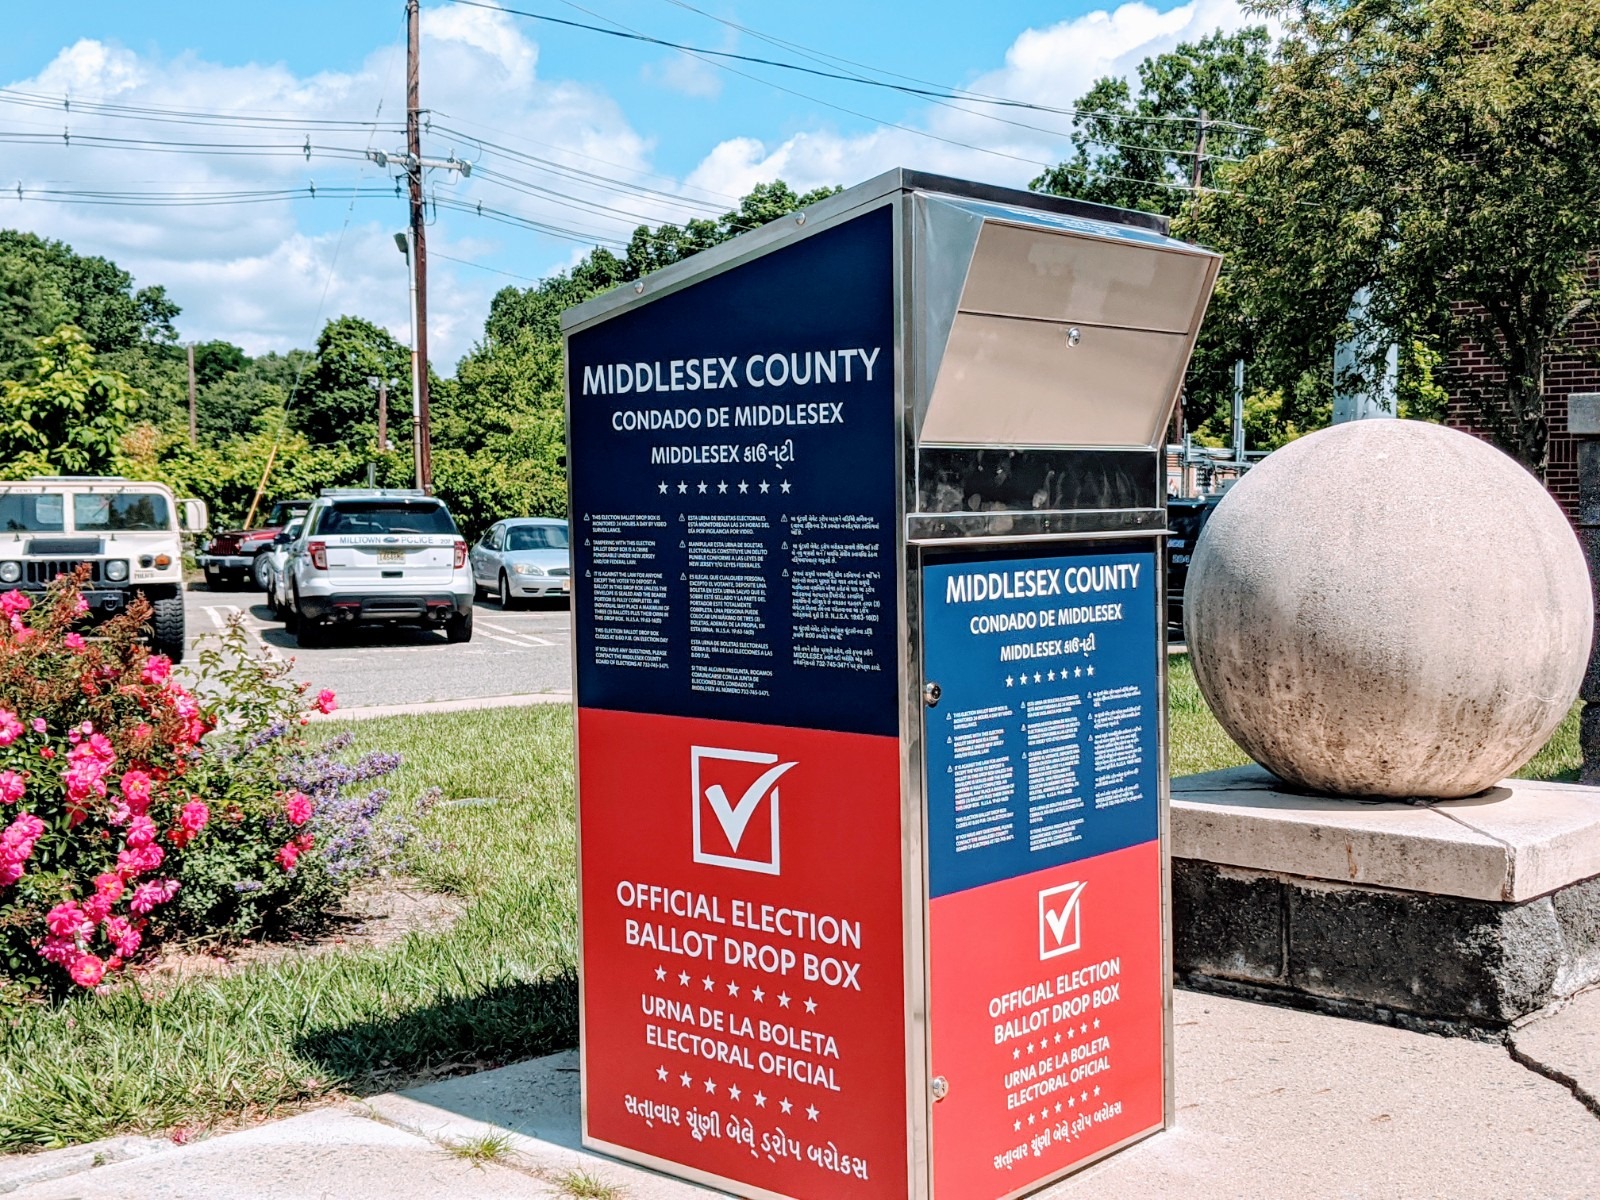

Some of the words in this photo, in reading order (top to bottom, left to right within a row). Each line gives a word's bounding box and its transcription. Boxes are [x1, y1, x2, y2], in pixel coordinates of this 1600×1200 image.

[583, 357, 738, 395] MIDDLESEX
[746, 347, 880, 387] COUNTY
[612, 408, 702, 431] CONDADO
[706, 407, 729, 428] DE
[734, 402, 844, 426] MIDDLESEX
[651, 445, 740, 464] MIDDLESEX
[340, 536, 381, 544] MILLTOWN
[401, 536, 434, 544] POLICE
[946, 568, 1061, 603] MIDDLESEX
[1064, 563, 1140, 594] COUNTY
[970, 612, 1036, 635] CONDADO
[1040, 610, 1055, 628] DE
[1058, 603, 1122, 626] MIDDLESEX
[1000, 640, 1062, 662] MIDDLESEX
[617, 881, 726, 924] OFFICIAL
[732, 900, 861, 949] ELECTION
[625, 919, 717, 961] BALLOT
[725, 938, 796, 975] DROP
[804, 953, 861, 991] BOX
[988, 980, 1054, 1018] OFFICIAL
[1057, 957, 1120, 994] ELECTION
[994, 1008, 1049, 1045] BALLOT
[1052, 996, 1090, 1026] DROP
[1093, 983, 1120, 1010] BOX
[642, 994, 696, 1025] URNA
[700, 1007, 723, 1032] DE
[730, 1014, 755, 1039] LA
[760, 1020, 839, 1059] BOLETA
[646, 1024, 754, 1070] ELECTORAL
[758, 1051, 840, 1091] OFICIAL
[1004, 1061, 1037, 1090] URNA
[1039, 1057, 1053, 1075] DE
[1055, 1051, 1070, 1069] LA
[1071, 1035, 1110, 1063] BOLETA
[1007, 1072, 1069, 1110] ELECTORAL
[1071, 1055, 1110, 1084] OFICIAL
